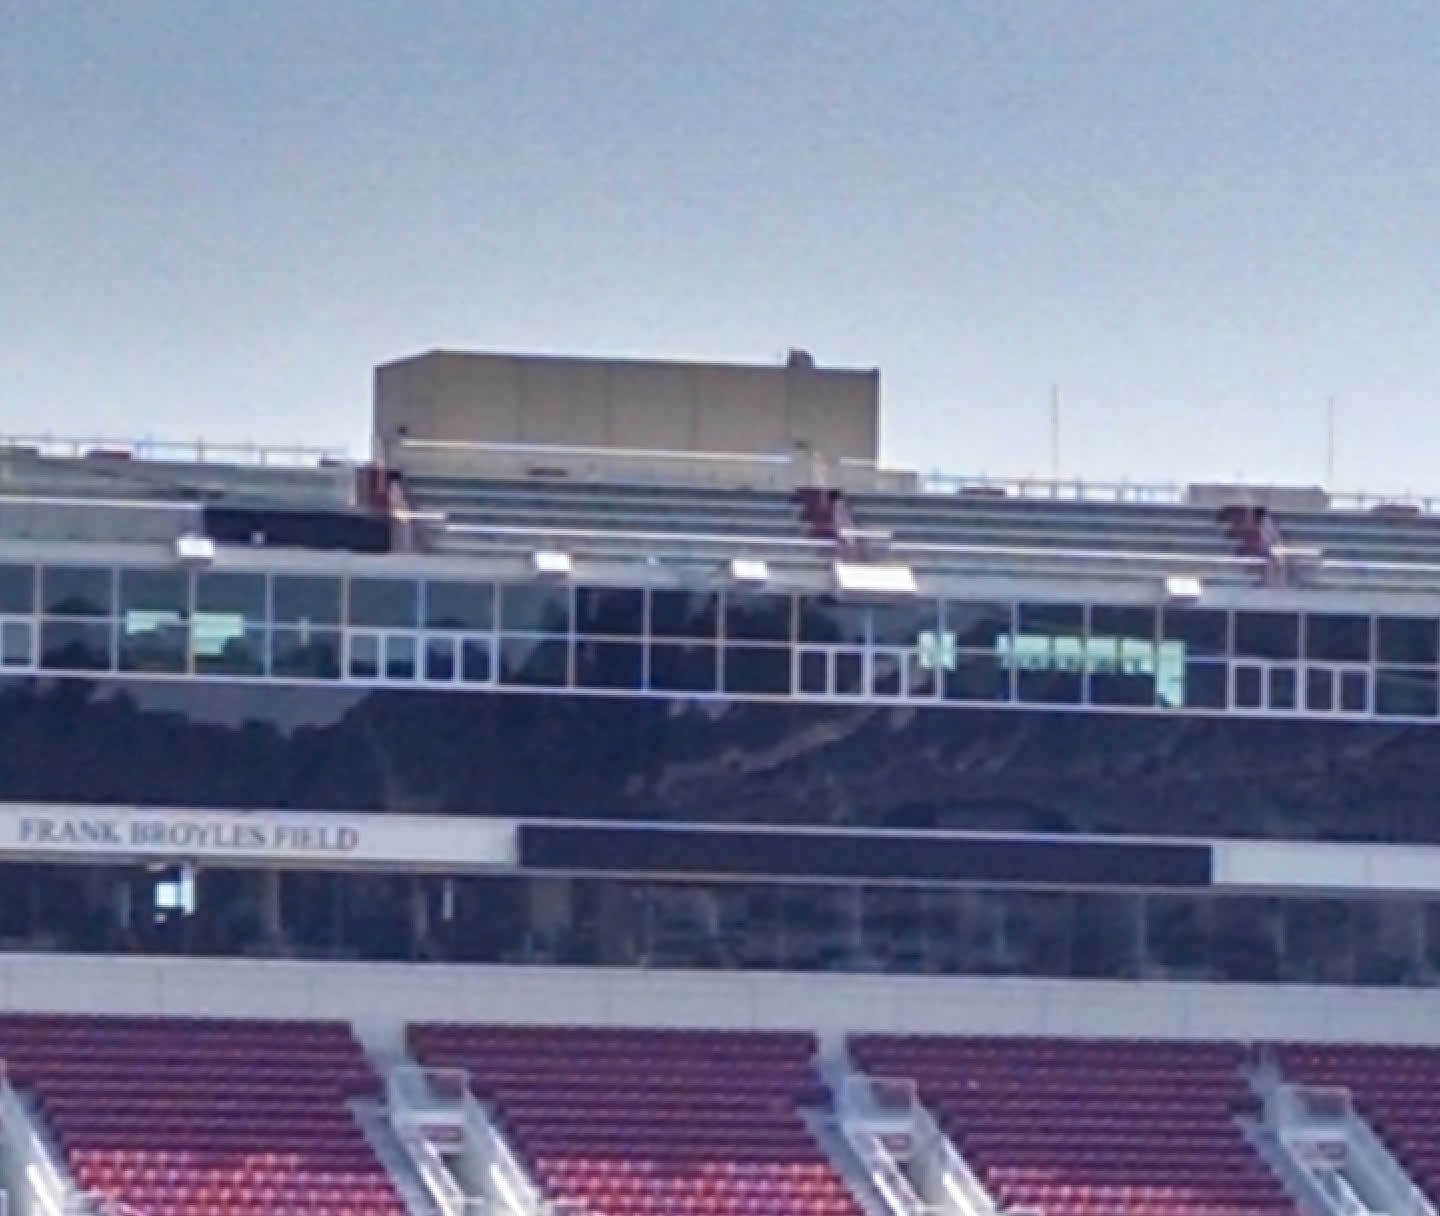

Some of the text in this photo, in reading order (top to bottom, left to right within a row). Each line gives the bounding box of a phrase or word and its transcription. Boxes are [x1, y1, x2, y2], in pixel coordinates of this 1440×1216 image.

[17, 816, 361, 850] FRANK BROYLES FIELD
